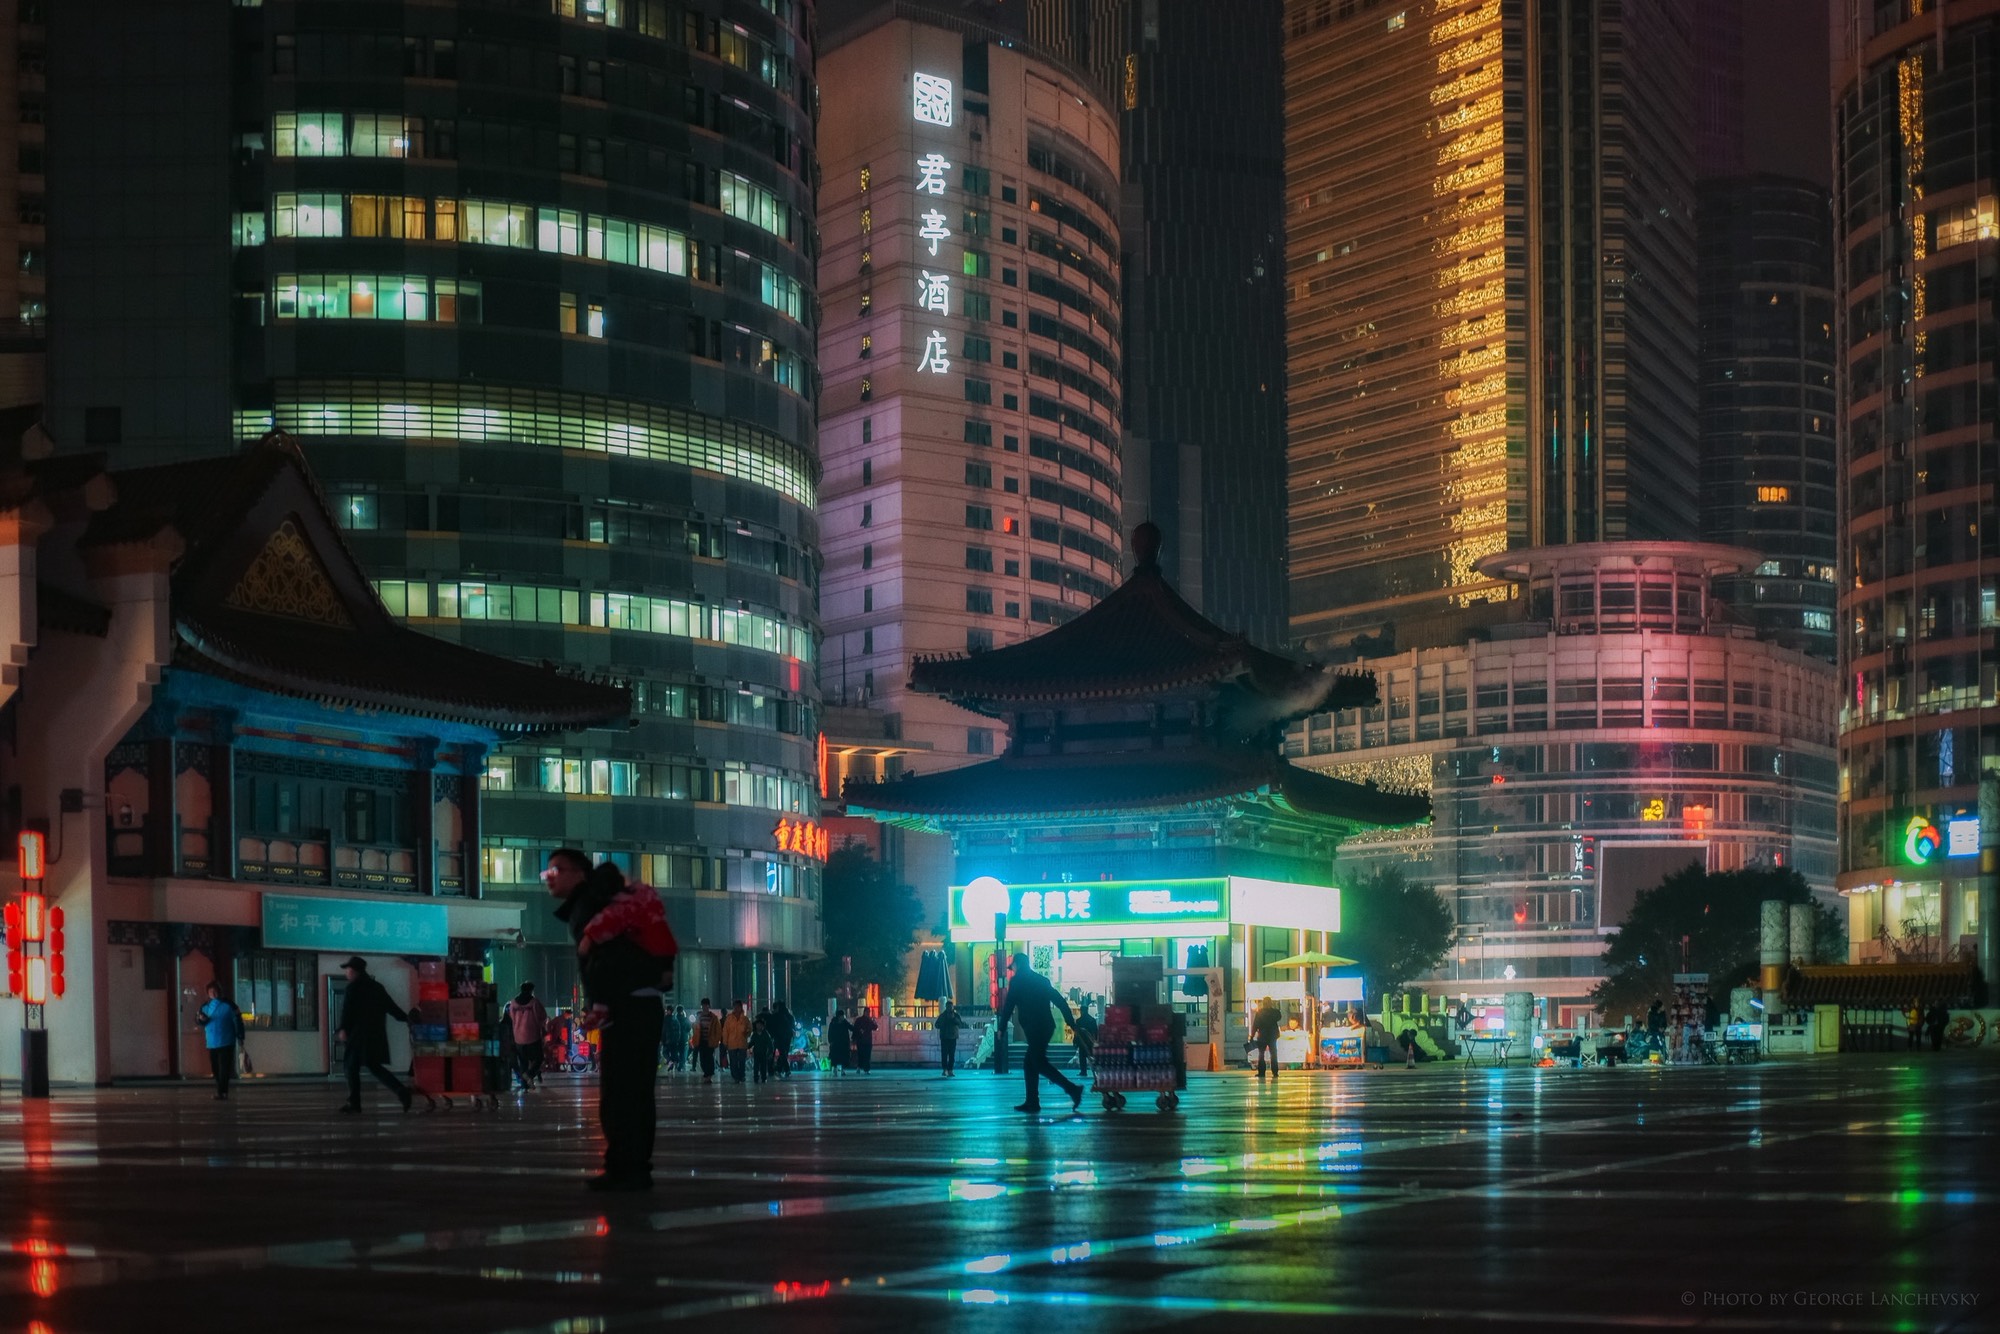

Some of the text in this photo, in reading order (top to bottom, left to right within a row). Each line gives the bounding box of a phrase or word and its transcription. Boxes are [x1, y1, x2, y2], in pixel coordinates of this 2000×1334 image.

[916, 153, 951, 373] 君亭酒店
[279, 912, 435, 941] 和平新健康药房
